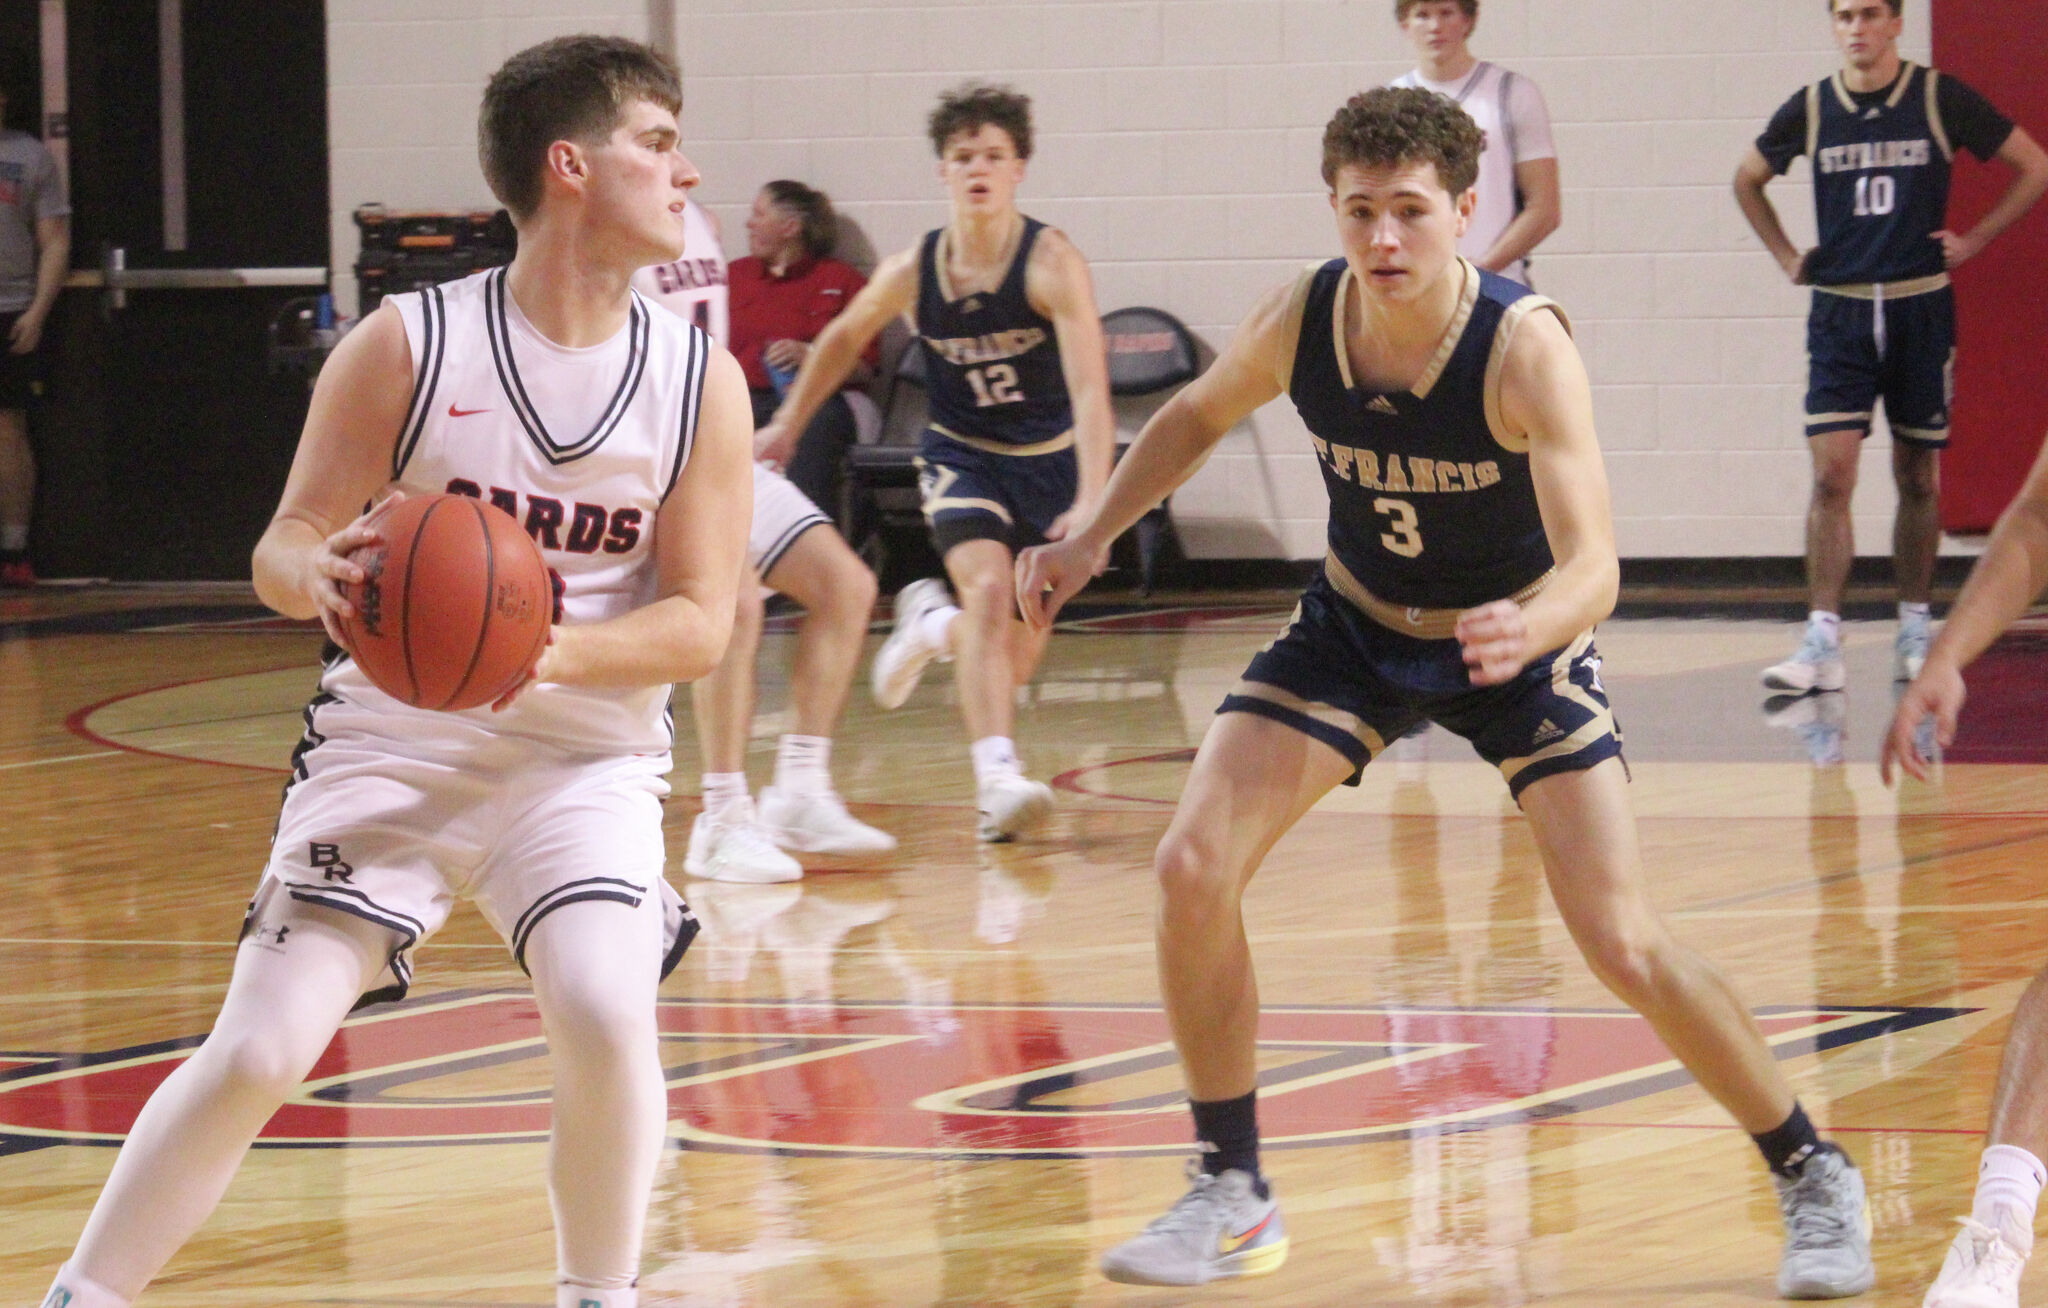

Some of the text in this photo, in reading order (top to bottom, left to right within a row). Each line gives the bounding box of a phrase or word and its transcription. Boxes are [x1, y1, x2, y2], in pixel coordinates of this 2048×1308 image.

[1853, 175, 1895, 216] 10
[965, 364, 1025, 407] 12
[1309, 430, 1501, 493] T.FRANCIS
[446, 478, 642, 554] RDS
[1373, 497, 1424, 558] 3
